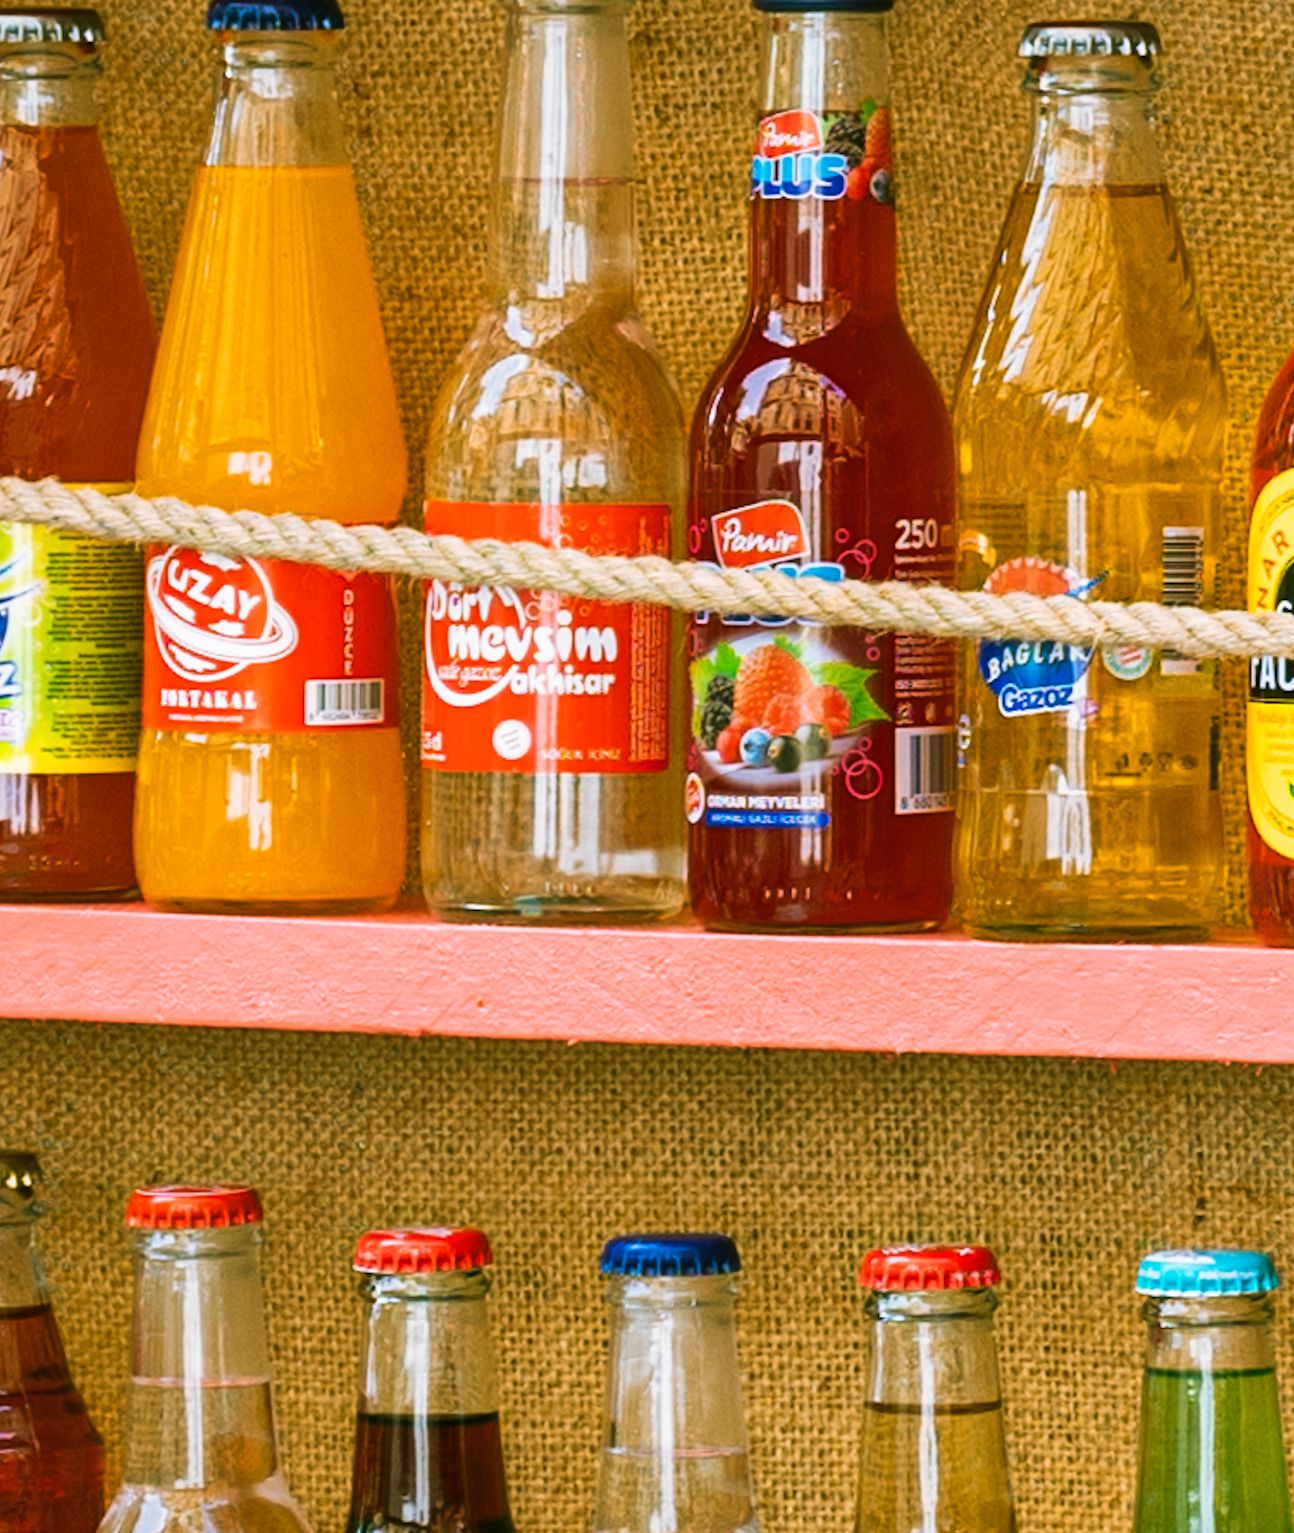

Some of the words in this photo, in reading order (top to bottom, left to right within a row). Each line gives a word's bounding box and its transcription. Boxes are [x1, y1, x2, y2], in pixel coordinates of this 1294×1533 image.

[721, 517, 798, 553] Pamir
[895, 518, 938, 550] 250
[166, 557, 262, 621] UZAY
[447, 610, 618, 664] mevsim
[511, 661, 615, 695] akhisar
[160, 689, 257, 710] PORTAKAL
[1002, 685, 1075, 713] Gazoz
